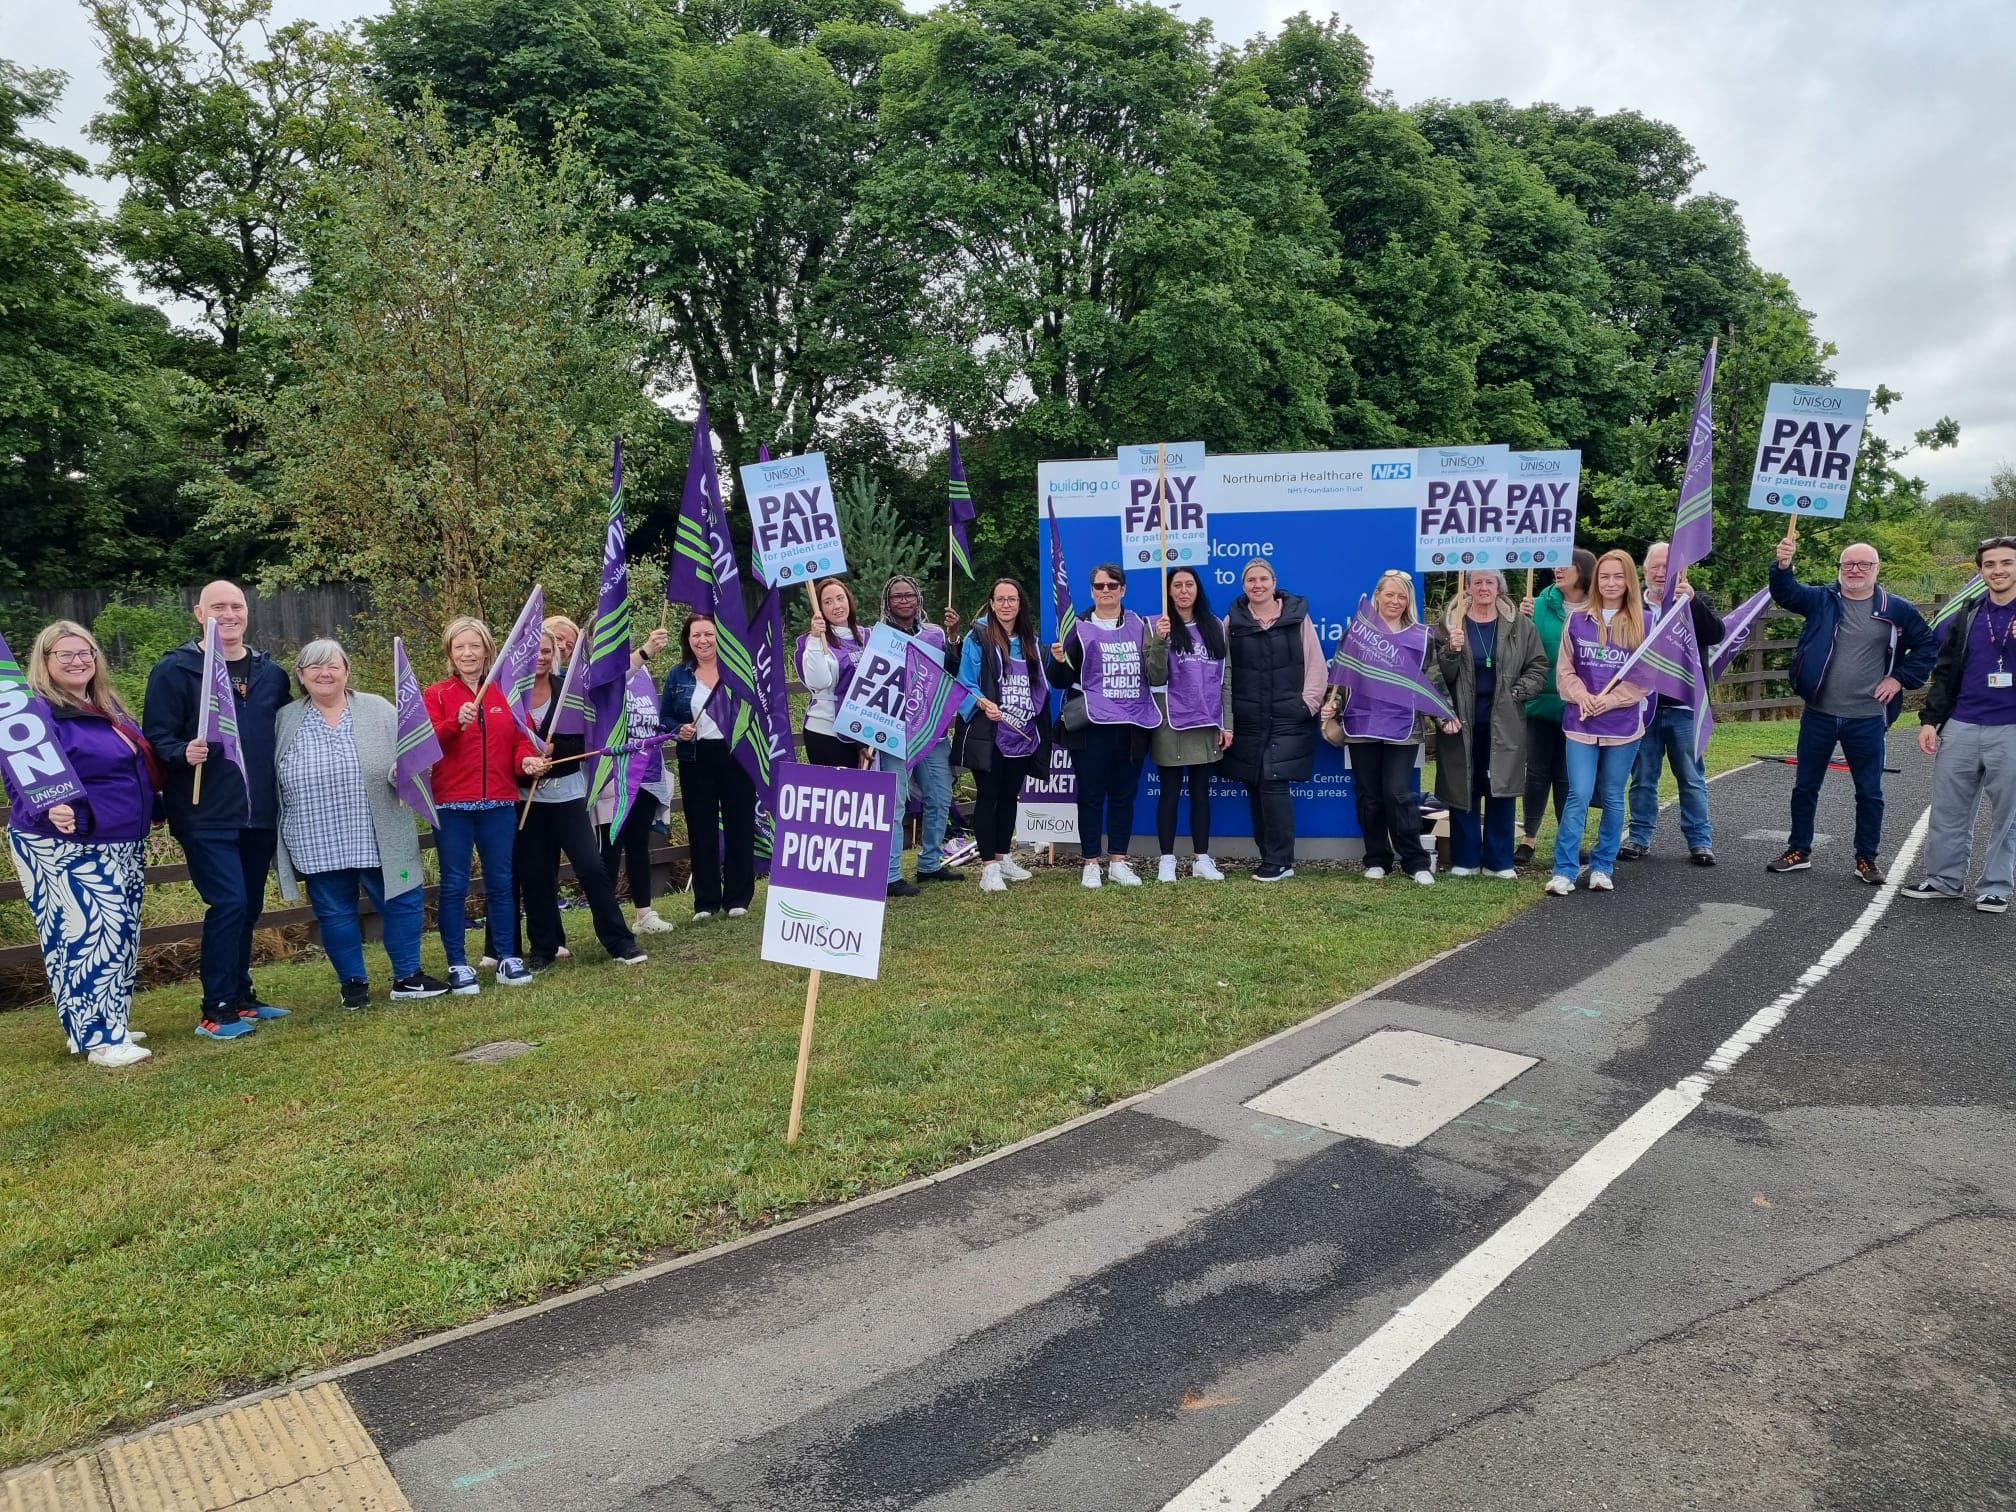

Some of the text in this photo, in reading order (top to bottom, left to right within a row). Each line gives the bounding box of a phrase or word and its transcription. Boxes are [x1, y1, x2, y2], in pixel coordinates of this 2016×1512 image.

[1793, 395, 1842, 409] UNISON
[1772, 419, 1852, 451] PAY
[1141, 453, 1184, 466] UNION
[1440, 456, 1485, 468] UNISON
[1520, 461, 1561, 471] UNISON
[1760, 445, 1851, 481] FAIR
[764, 465, 806, 482] UNISON
[1222, 464, 1411, 484] Northumbria Healthcare NHS
[1756, 473, 1847, 491] for patient care
[1050, 480, 1097, 494] building
[1100, 481, 1109, 490] a
[1130, 475, 1197, 506] PAY
[1287, 485, 1364, 495] NHS Foundation Trust
[1428, 478, 1498, 508] PAY
[1507, 482, 1571, 509] PAY
[758, 485, 822, 523] PAY
[1125, 502, 1204, 533] FAIR
[1420, 506, 1504, 535] FAIR
[758, 512, 837, 552] FAIR
[1125, 533, 1140, 543] for
[1181, 530, 1205, 540] care
[1419, 536, 1436, 545] for
[1437, 534, 1476, 546] patient
[1478, 535, 1503, 543] care
[1512, 534, 1547, 546] patient
[1550, 535, 1572, 543] care
[763, 539, 840, 562] for patient care
[1214, 568, 1236, 585] to
[1099, 640, 1138, 654] UNISON
[1351, 620, 1399, 658] UNISON
[865, 655, 906, 692] PA
[1102, 661, 1141, 676] UP FOR
[1001, 674, 1030, 687] UNIS
[1102, 675, 1141, 689] PUBLIC
[849, 676, 906, 722] FAI
[1001, 686, 1031, 697] SPEAKI
[1001, 695, 1019, 705] UP
[1102, 688, 1140, 699] SERVICES
[845, 700, 859, 711] for
[860, 706, 895, 727] patient
[1025, 774, 1076, 794] PICKET
[1313, 773, 1352, 783] Centre
[30, 780, 74, 804] UNISON
[1220, 788, 1238, 797] are
[1317, 789, 1348, 797] areas
[779, 784, 891, 832] OFFICIAL
[1027, 819, 1074, 831] UNISON
[781, 831, 873, 878] PICKET
[780, 919, 862, 952] UNISON
